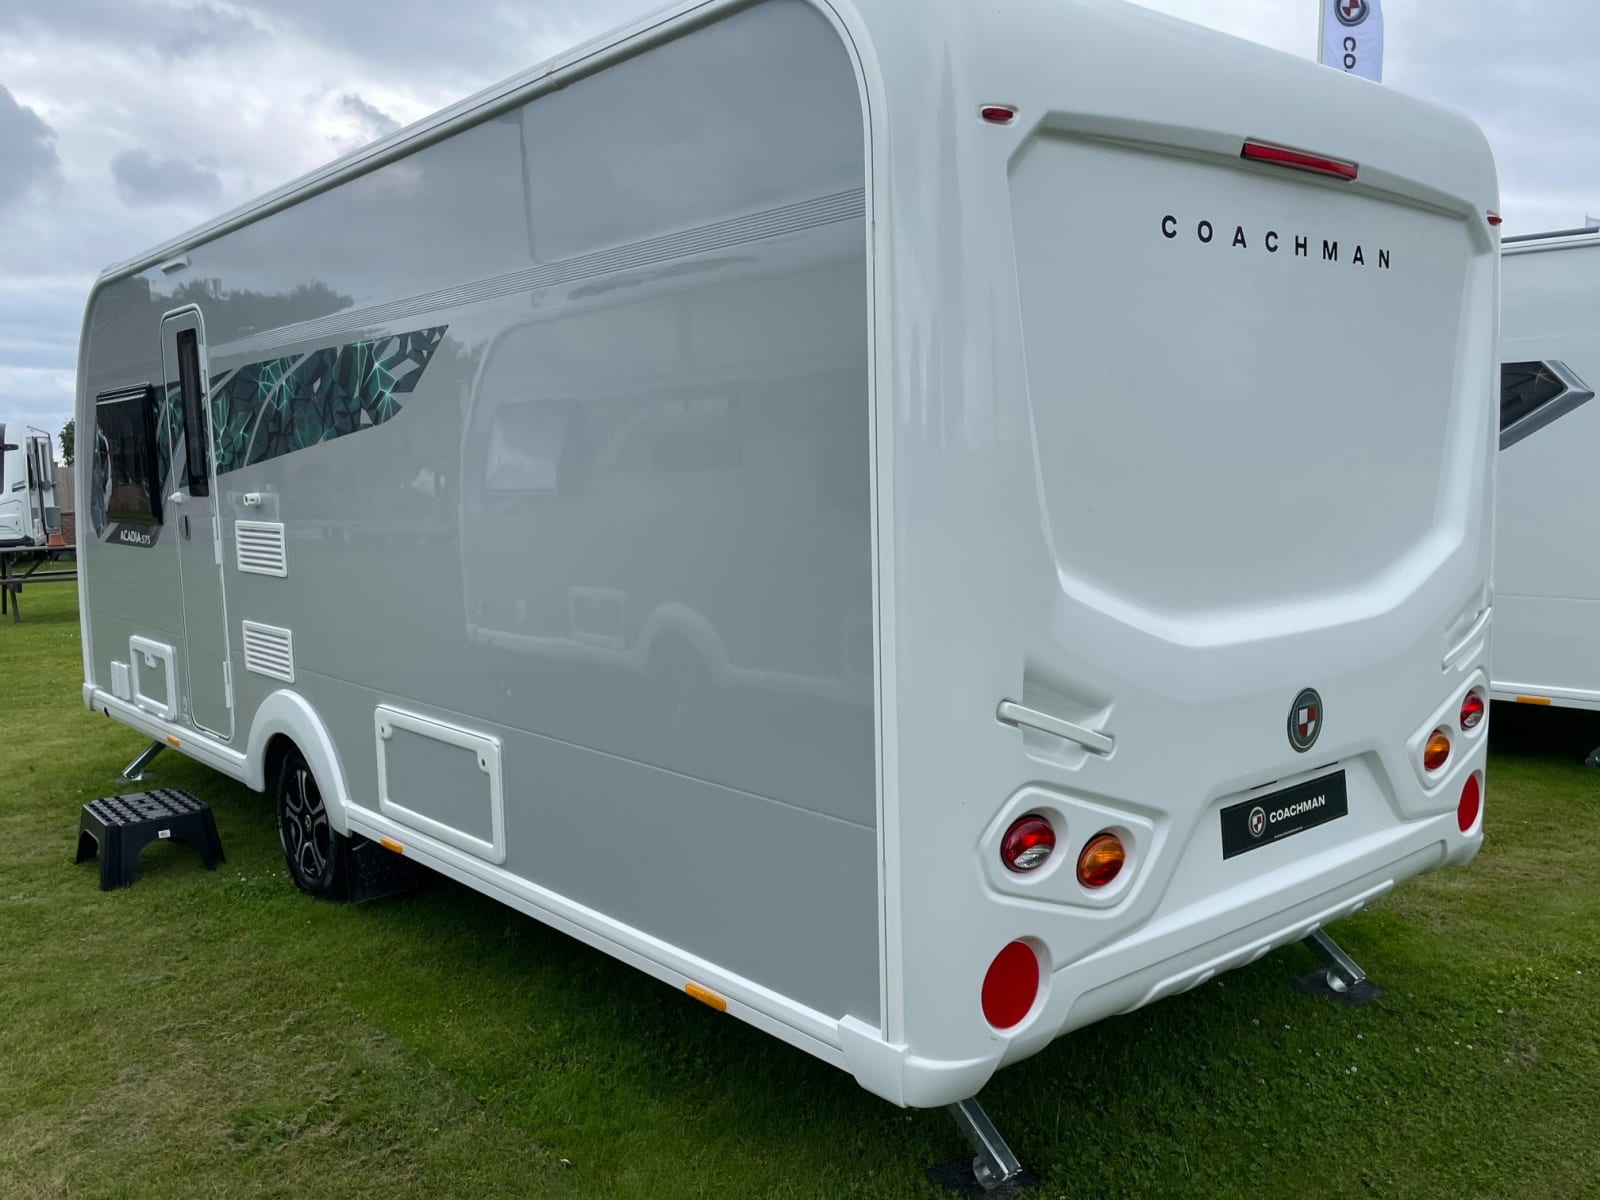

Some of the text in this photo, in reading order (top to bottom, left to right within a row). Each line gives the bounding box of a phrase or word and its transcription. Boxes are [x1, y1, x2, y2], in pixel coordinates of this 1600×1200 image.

[1343, 36, 1356, 73] CO
[1161, 214, 1391, 270] COACHMAN
[120, 529, 151, 545] ACADIA 575
[1269, 794, 1326, 824] COACHMAN
